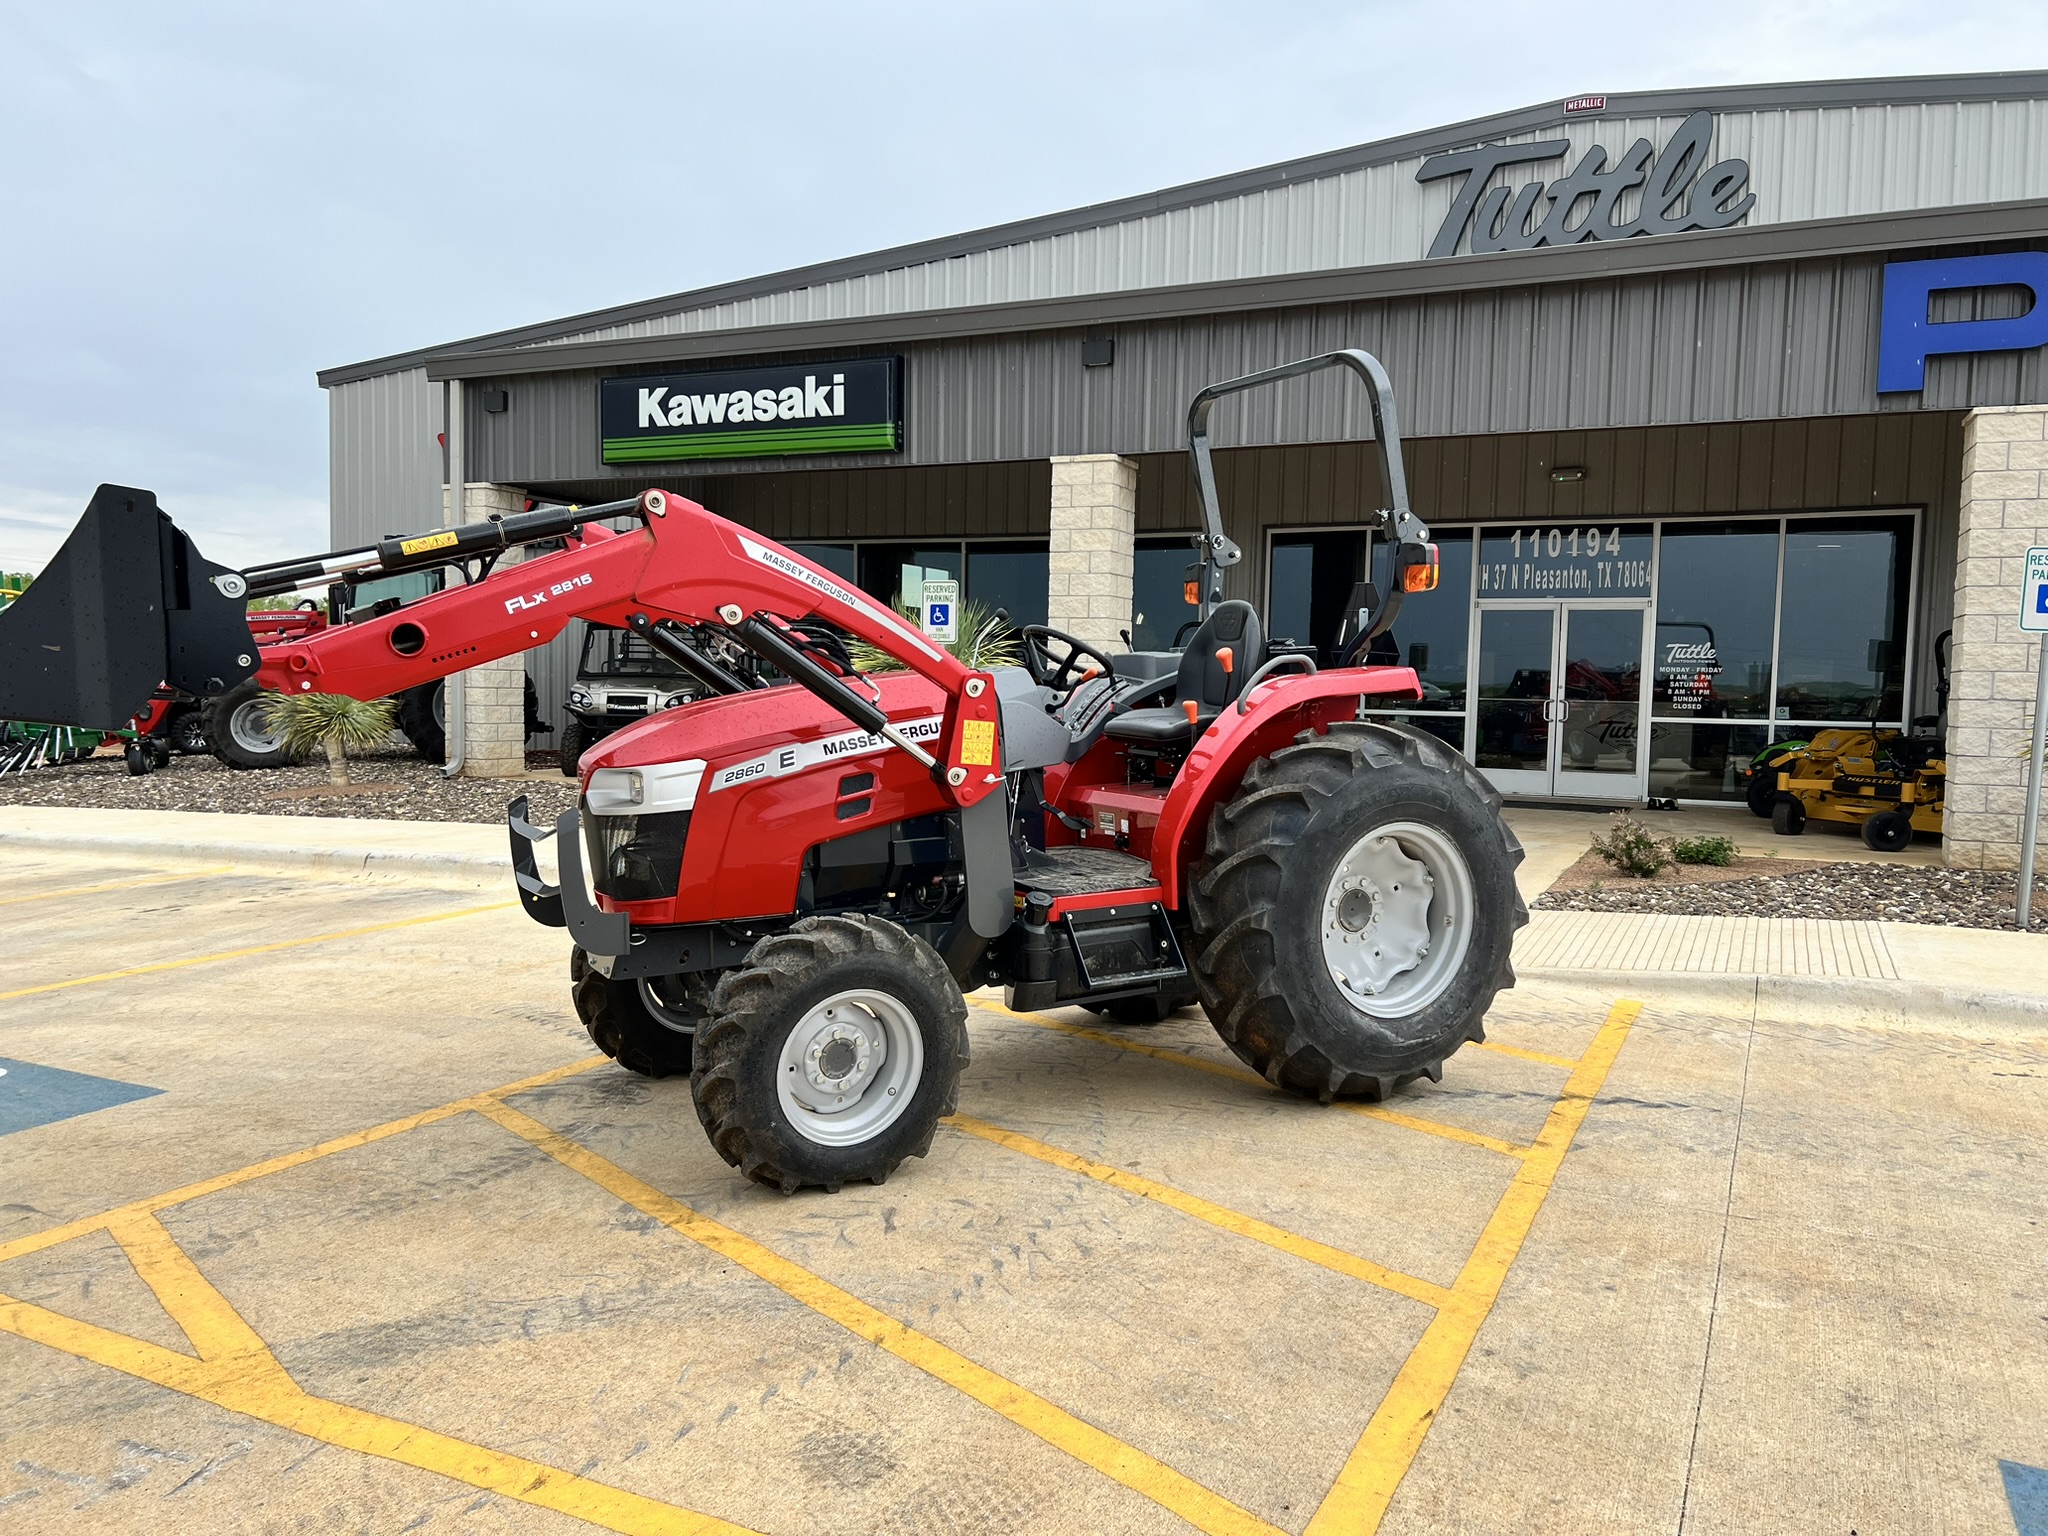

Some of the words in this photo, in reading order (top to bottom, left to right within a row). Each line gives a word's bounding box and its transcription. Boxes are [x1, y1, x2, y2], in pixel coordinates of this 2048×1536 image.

[1567, 98, 1603, 110] METALLIC
[1415, 110, 1757, 259] Tuttle
[638, 373, 845, 428] Kawasaki
[1510, 527, 1621, 558] 110194
[550, 573, 593, 596] 2815
[762, 551, 805, 577] MASSEY
[805, 573, 857, 606] FERGUSON
[924, 584, 956, 594] RESERVED
[1493, 563, 1507, 590] 37
[1511, 563, 1519, 590] N
[1523, 563, 1592, 594] Pleasanton,
[1597, 561, 1612, 588] TX
[1617, 560, 1651, 588] 78064
[926, 594, 954, 603] PARKING
[1666, 641, 1717, 664] Tuttle
[724, 762, 765, 784] 2860
[779, 749, 796, 769] E
[822, 733, 886, 756] MASSEY
[899, 721, 943, 739] ERGU
[1847, 776, 1901, 785] HUSTLER
